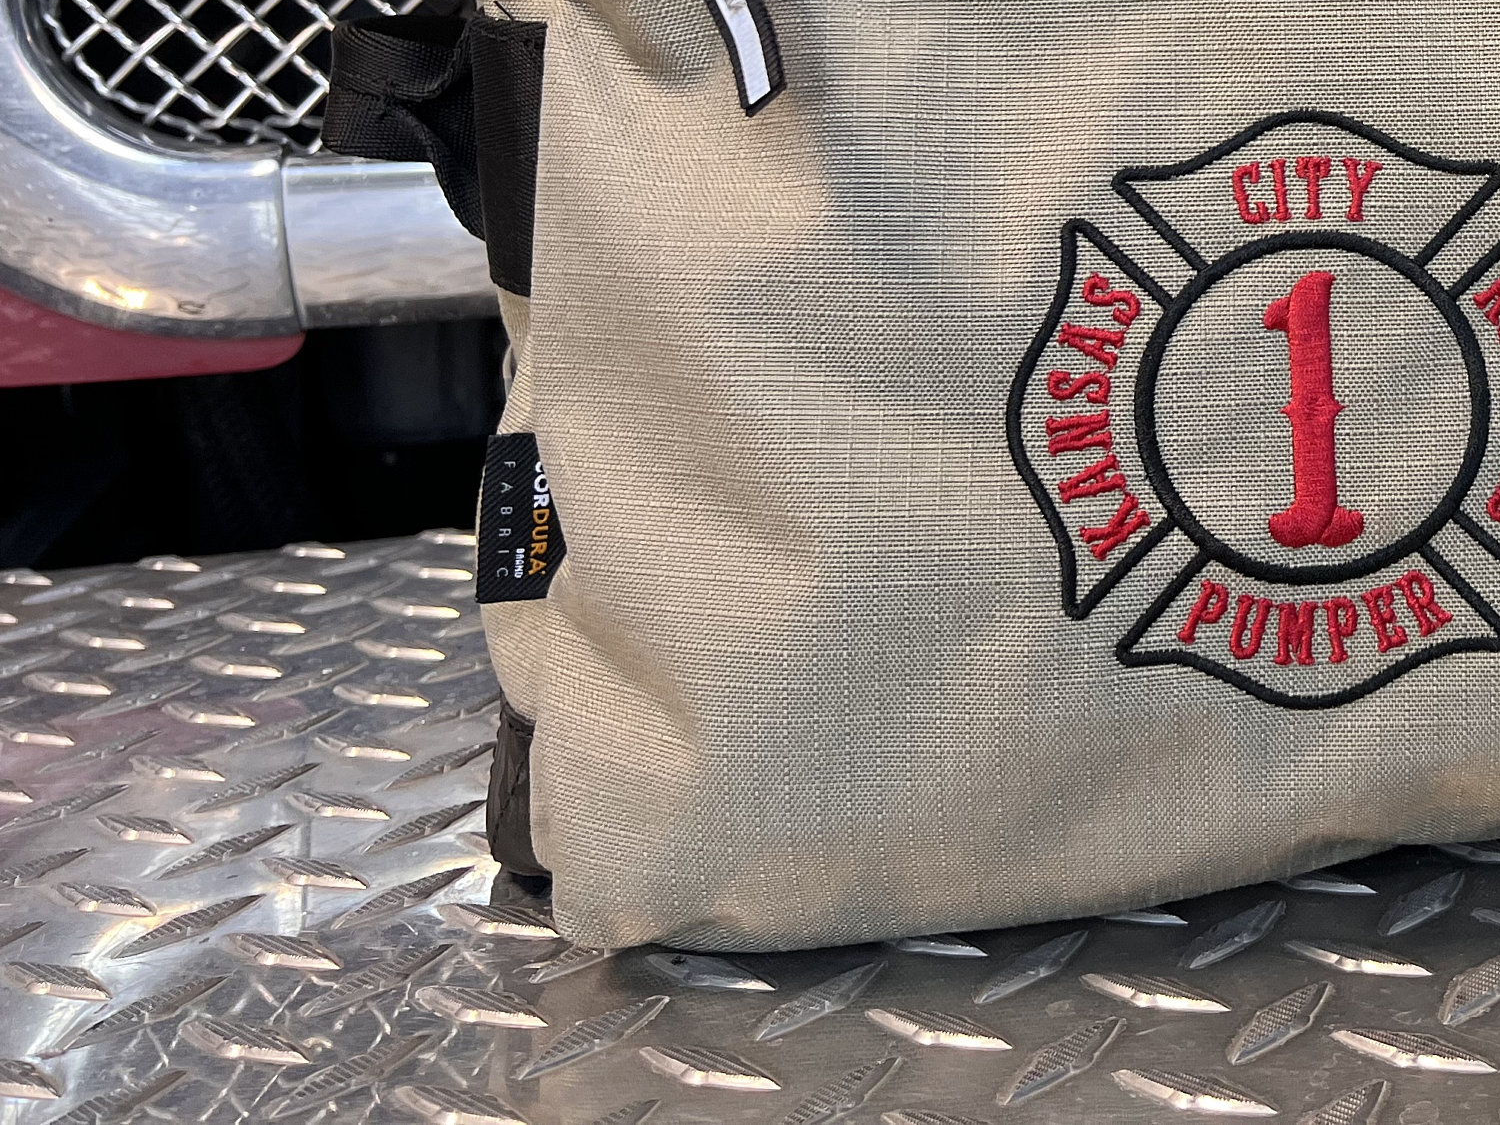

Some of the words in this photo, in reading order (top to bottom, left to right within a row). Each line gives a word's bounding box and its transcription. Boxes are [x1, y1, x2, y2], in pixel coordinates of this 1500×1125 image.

[1232, 157, 1382, 223] CITY
[1046, 273, 1150, 559] KANSAS
[1263, 271, 1363, 547] 1
[497, 461, 516, 577] FABRIC
[515, 548, 525, 579] BRAND
[1178, 571, 1452, 665] PUMPER
